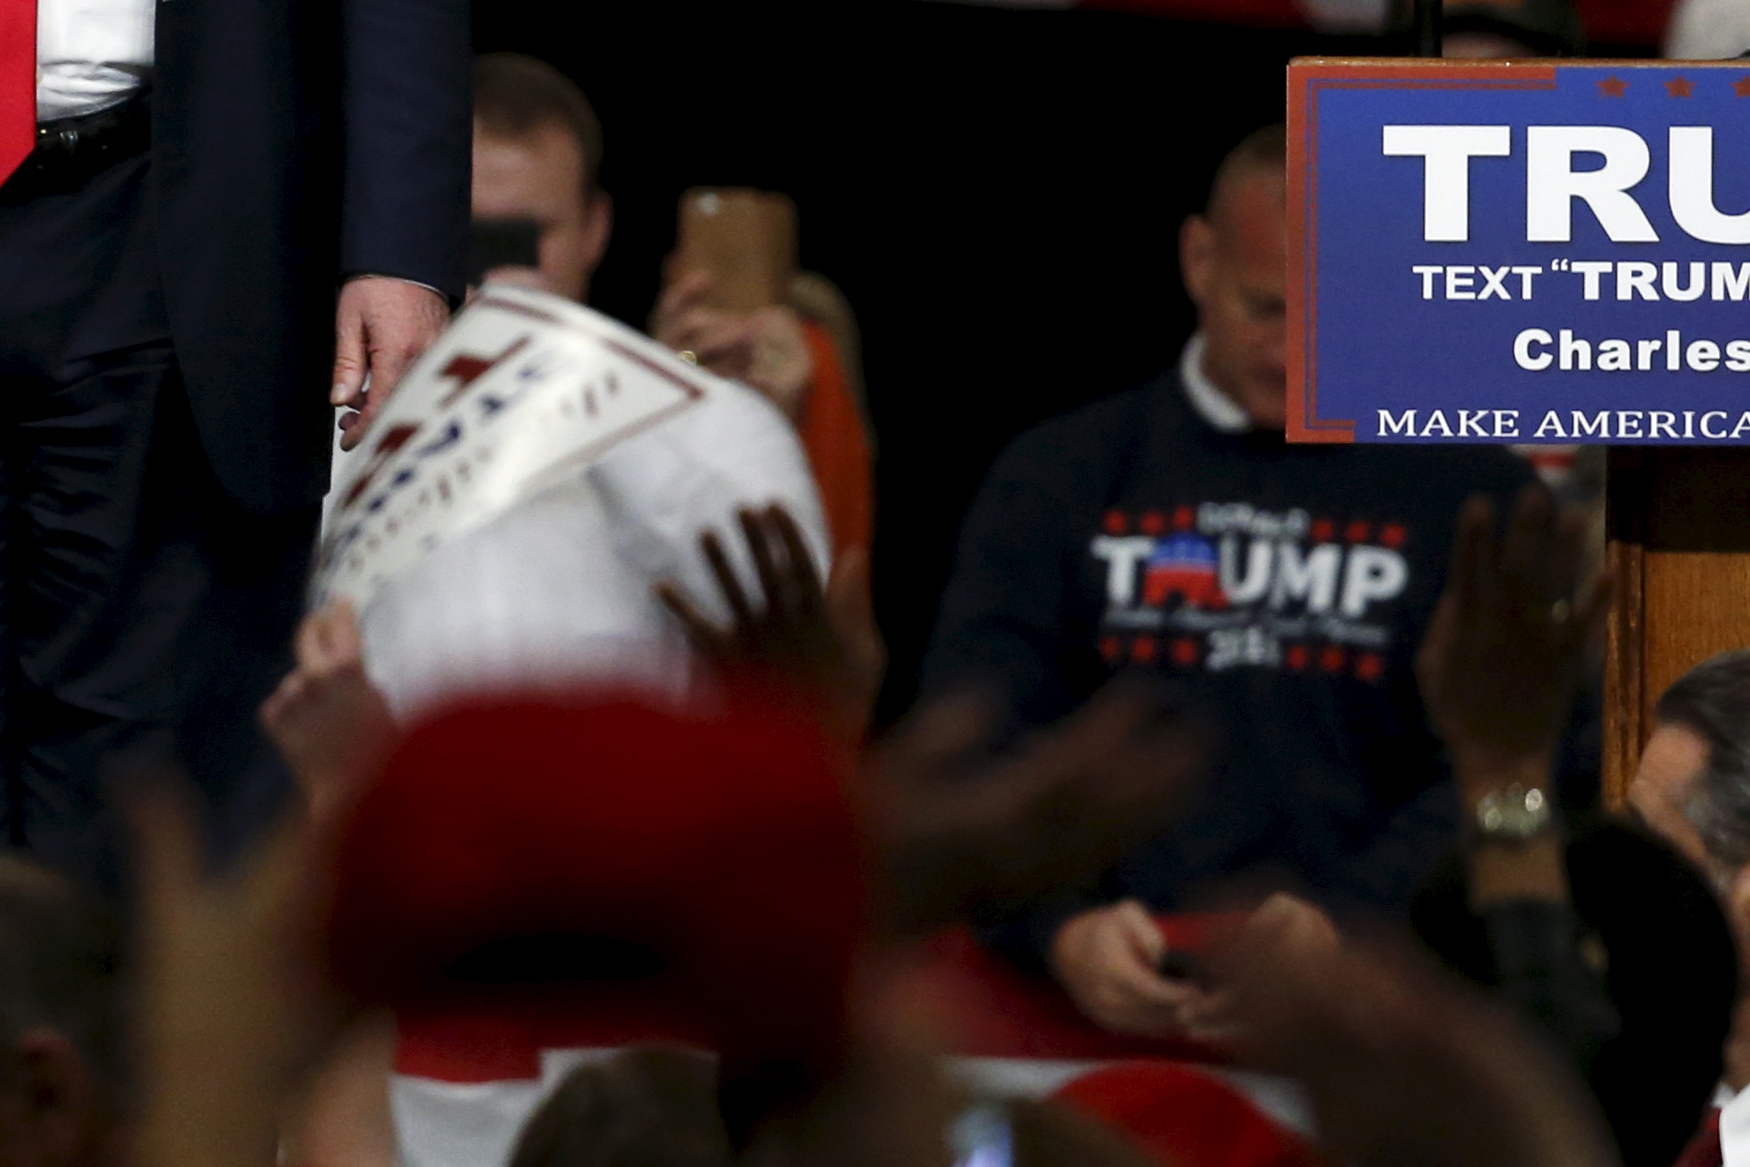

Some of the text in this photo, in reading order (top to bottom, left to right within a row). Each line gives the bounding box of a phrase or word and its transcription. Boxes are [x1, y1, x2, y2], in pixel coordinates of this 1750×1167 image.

[1382, 125, 1750, 245] TRU
[1412, 265, 1543, 300] TEXT
[1513, 328, 1750, 372] Charles
[1377, 409, 1520, 438] MAKE
[1091, 532, 1409, 618] TUMP
